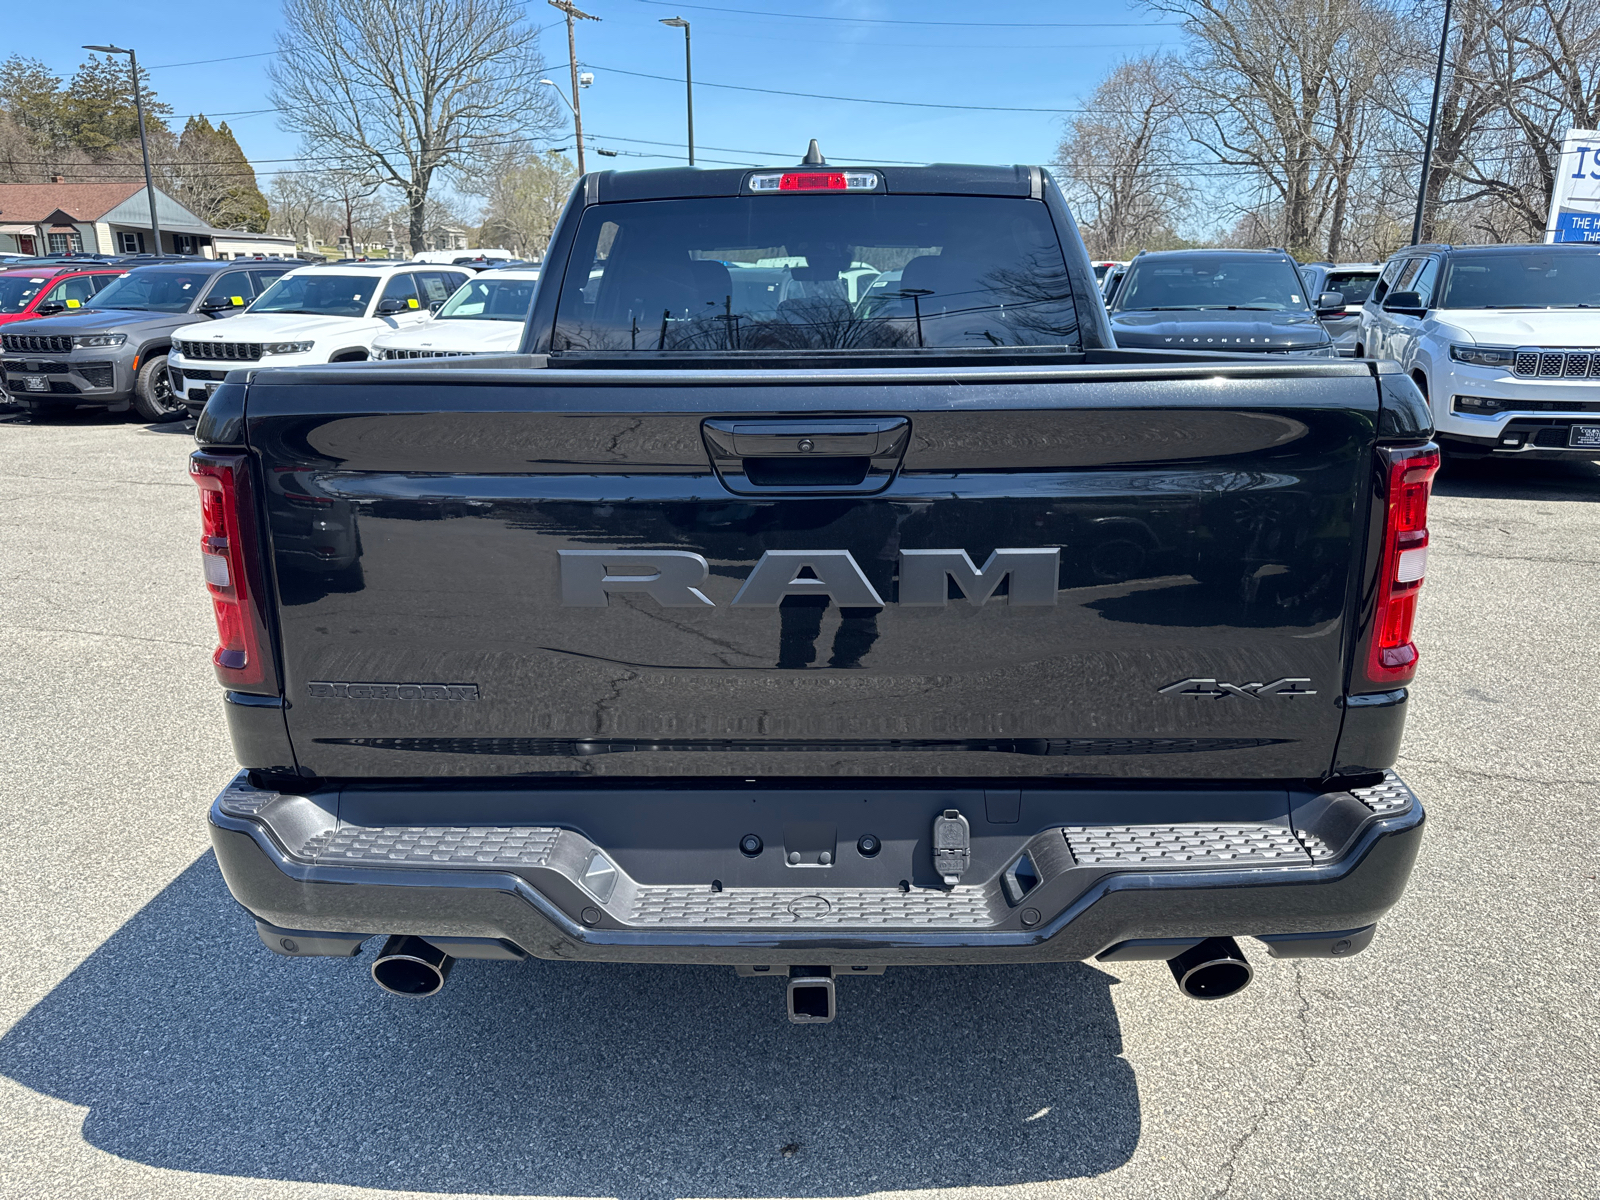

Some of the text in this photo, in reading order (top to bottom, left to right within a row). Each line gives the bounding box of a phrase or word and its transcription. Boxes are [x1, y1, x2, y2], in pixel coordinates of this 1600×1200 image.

[1572, 217, 1591, 230] THE
[556, 548, 1061, 608] RAM
[308, 681, 480, 700] BIGHORN
